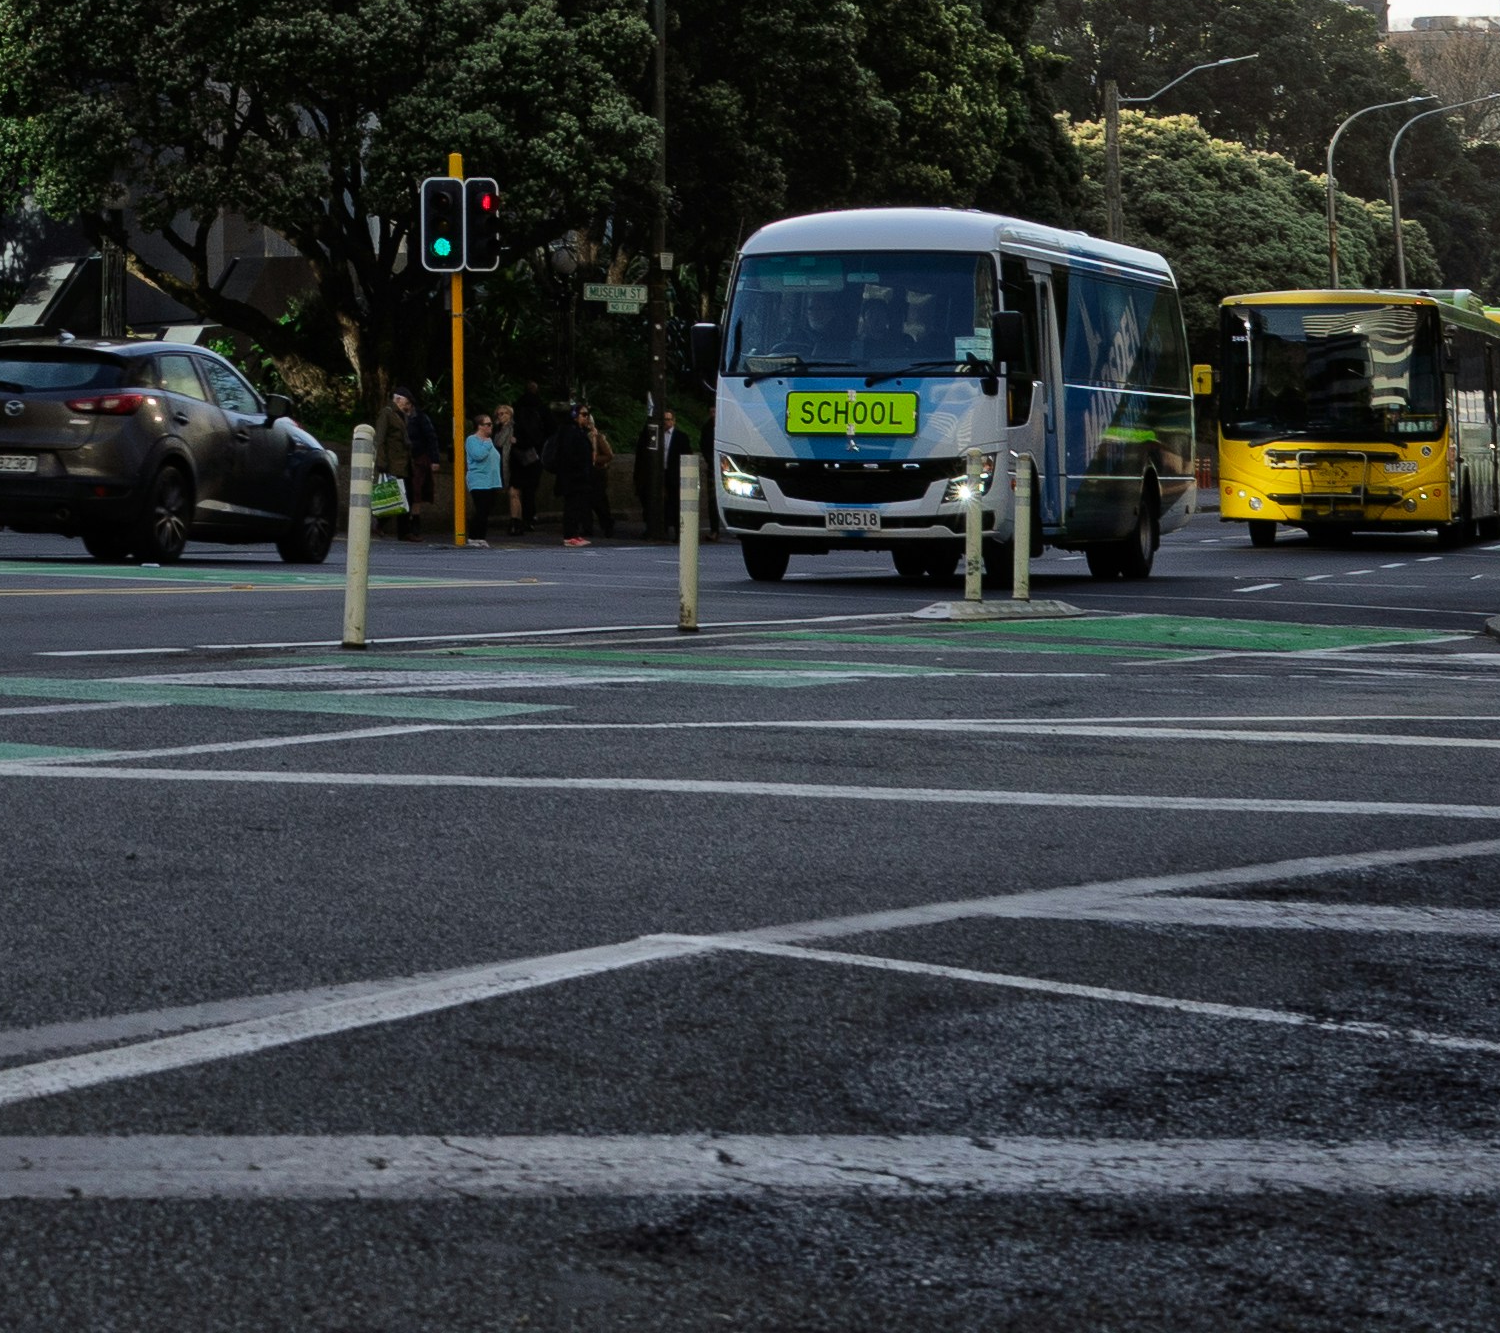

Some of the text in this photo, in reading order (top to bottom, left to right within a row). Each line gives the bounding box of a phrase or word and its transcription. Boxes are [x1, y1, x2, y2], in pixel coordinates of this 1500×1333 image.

[589, 286, 641, 299] MUSEUM ST
[800, 400, 902, 425] SCHOOL
[828, 512, 877, 526] RQC518
